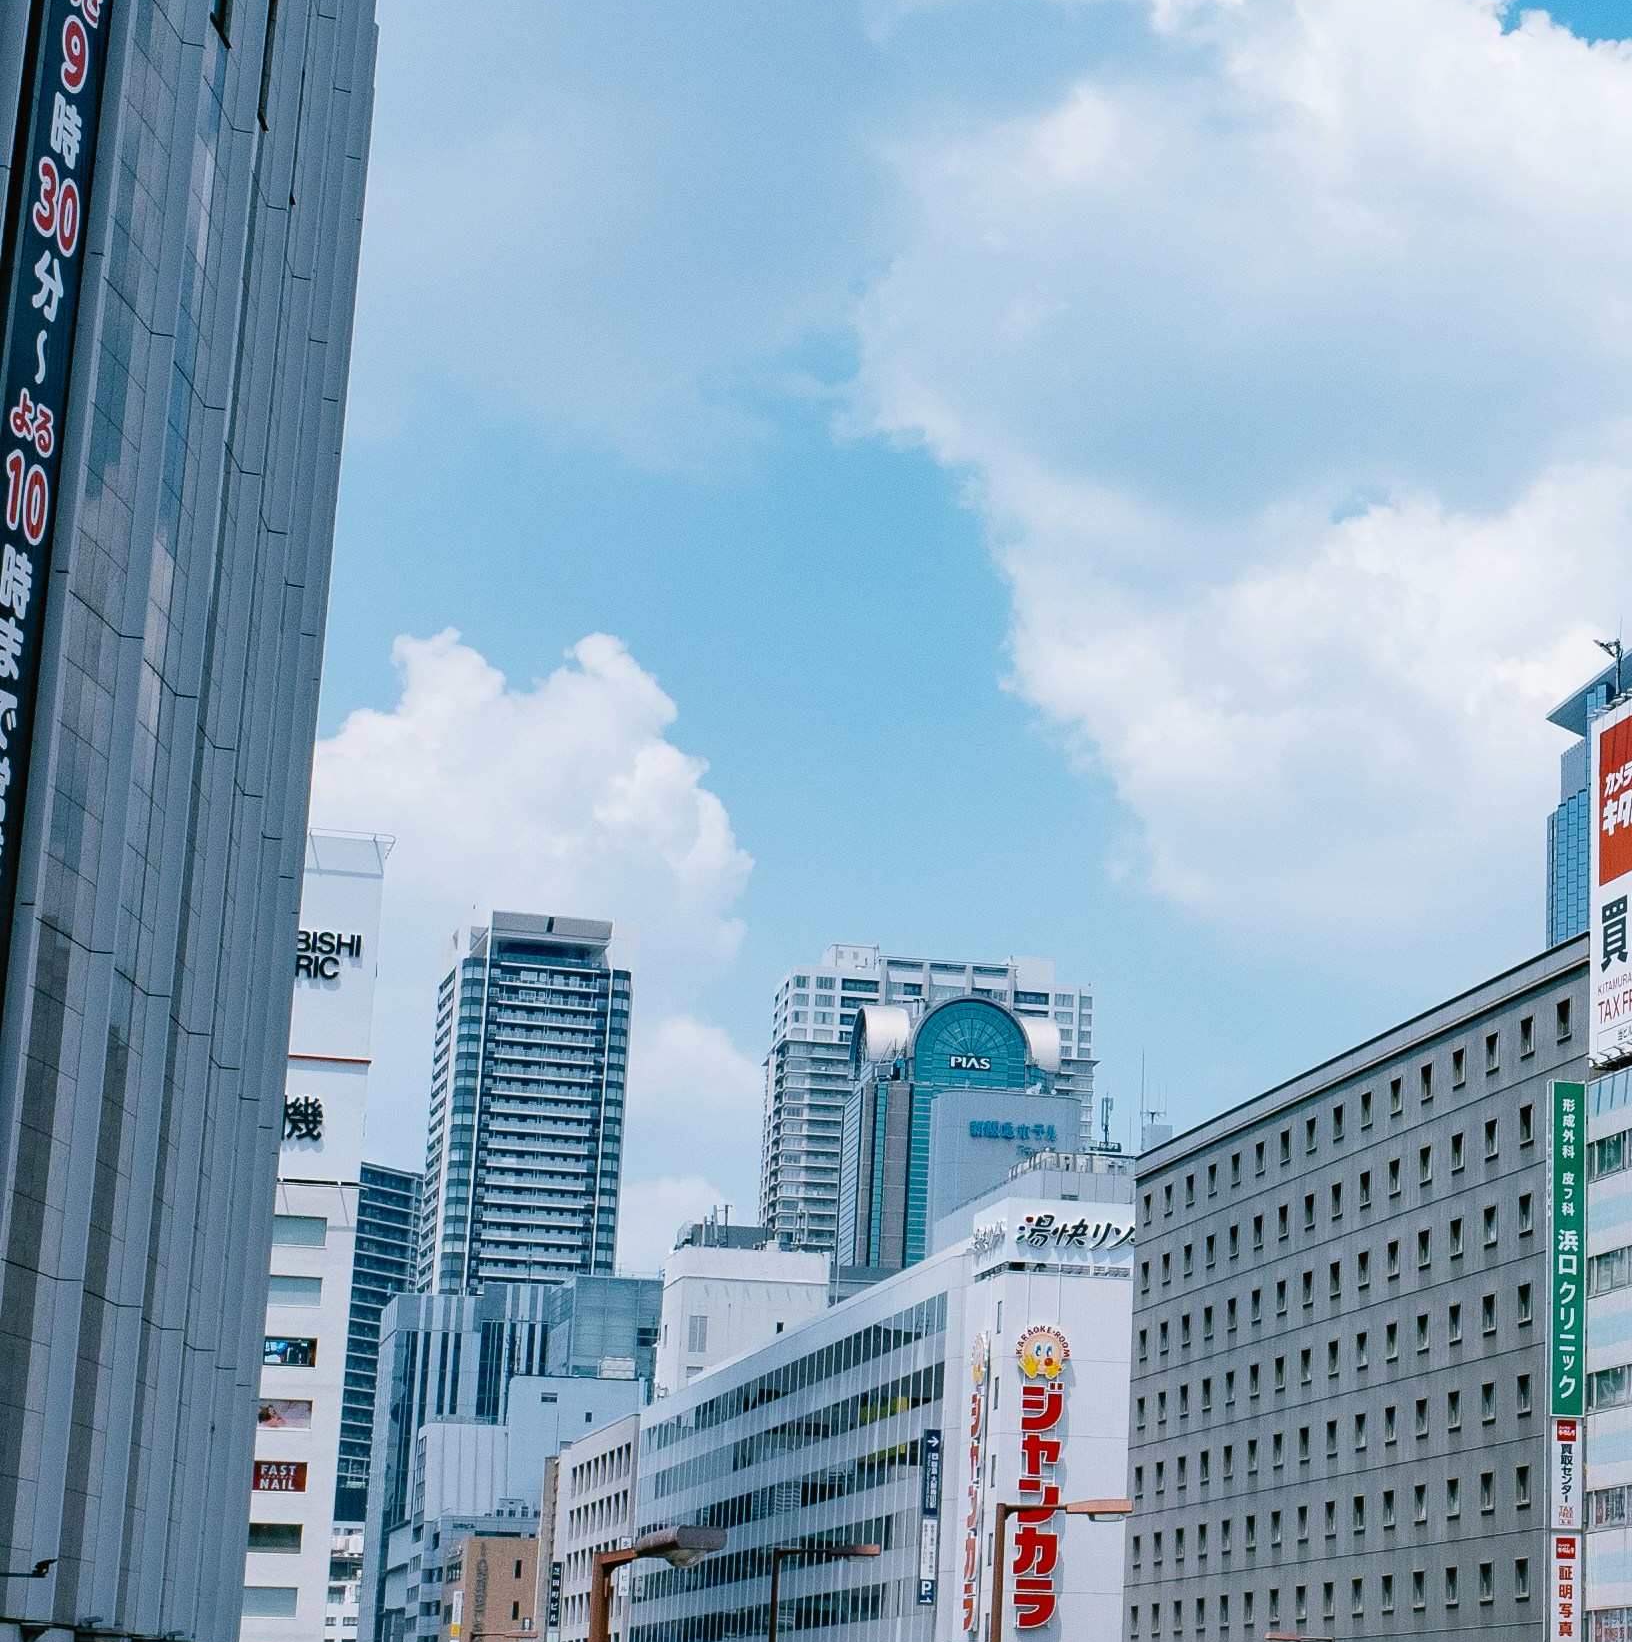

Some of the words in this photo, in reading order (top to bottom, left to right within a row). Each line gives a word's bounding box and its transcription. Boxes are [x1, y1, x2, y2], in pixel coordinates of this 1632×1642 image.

[1597, 971, 1632, 997] KITAMURA
[1598, 994, 1620, 1024] TAX
[950, 1055, 991, 1071] PIAS
[1562, 1098, 1576, 1159] 形成外科
[1562, 1171, 1575, 1218] 皮フ科
[1557, 1229, 1579, 1400] 浜口クリニック
[259, 1478, 295, 1491] NAIL
[260, 1464, 297, 1475] FAST
[1560, 1443, 1573, 1504] 買取センター
[1012, 1380, 1065, 1629] ジャンカラ
[1558, 1565, 1574, 1637] 証明写真
